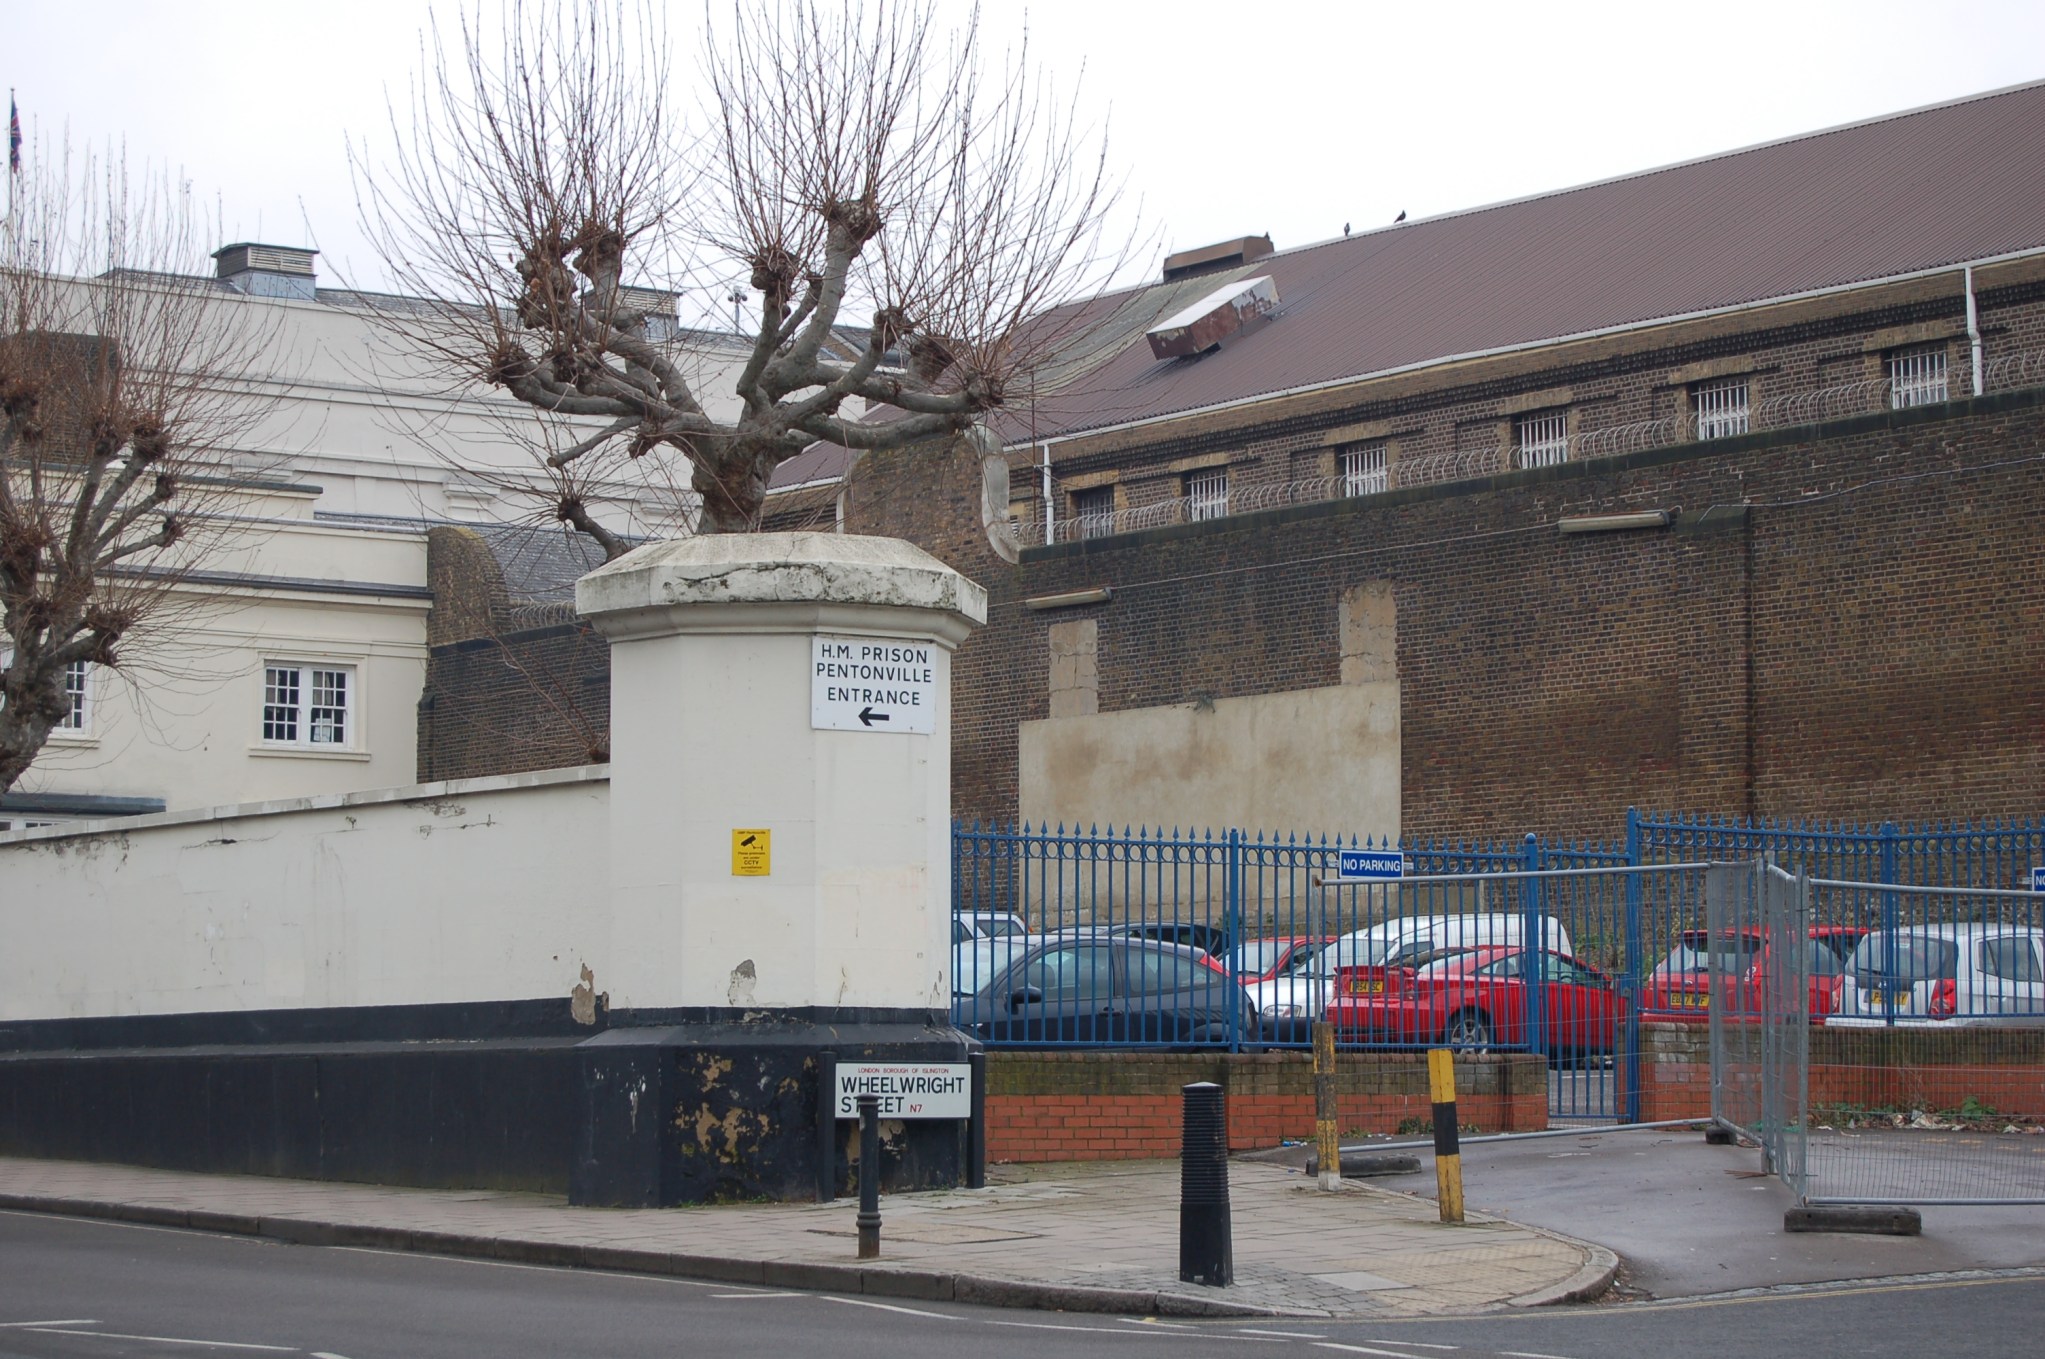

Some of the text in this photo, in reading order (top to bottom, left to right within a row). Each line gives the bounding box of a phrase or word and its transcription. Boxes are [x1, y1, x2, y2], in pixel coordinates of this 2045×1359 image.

[822, 643, 927, 664] H.M. PRISON
[816, 662, 932, 683] PENTONVILLE
[828, 687, 920, 706] ENTRANCE
[1343, 859, 1401, 872] NO PARKING
[841, 1076, 965, 1094] WHEELWRIGHT
[841, 1096, 923, 1114] STEET N7
